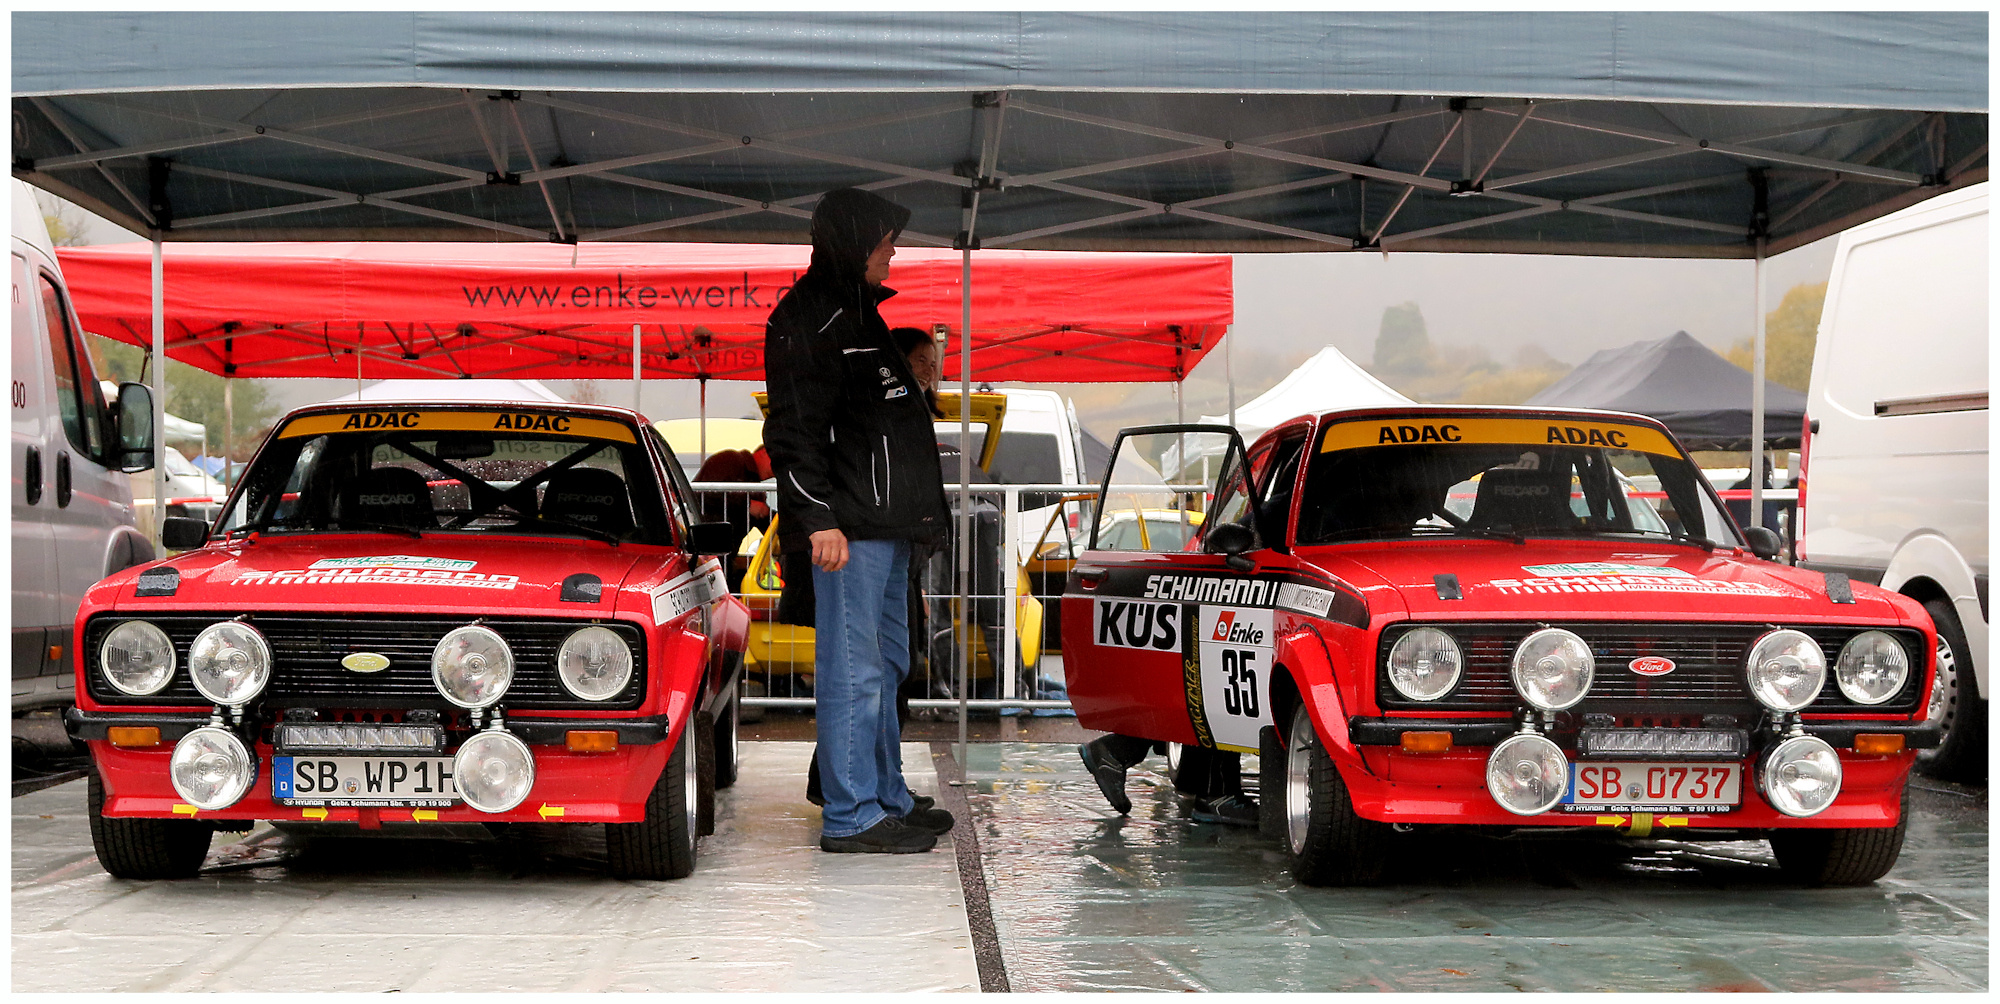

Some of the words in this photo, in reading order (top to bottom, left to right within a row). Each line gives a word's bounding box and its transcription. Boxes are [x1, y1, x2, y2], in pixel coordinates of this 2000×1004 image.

[343, 412, 420, 430] ADAC
[494, 413, 571, 432] ADAC
[1378, 425, 1462, 444] ADAC
[1547, 426, 1628, 448] ADAC
[359, 494, 416, 505] RECARO
[238, 568, 519, 584] SCHUMANN
[364, 576, 511, 589] MOTORSPORT
[1490, 575, 1774, 590] SCHUMANN
[1144, 574, 1265, 606] SCHUMANN
[1099, 601, 1178, 650] KÜS
[1228, 622, 1264, 645] Enke
[1639, 660, 1665, 671] Ford
[1221, 648, 1260, 719] 35
[280, 781, 288, 791] D
[295, 760, 339, 793] SB
[1578, 767, 1622, 799] SB
[1647, 767, 1731, 799] 0737
